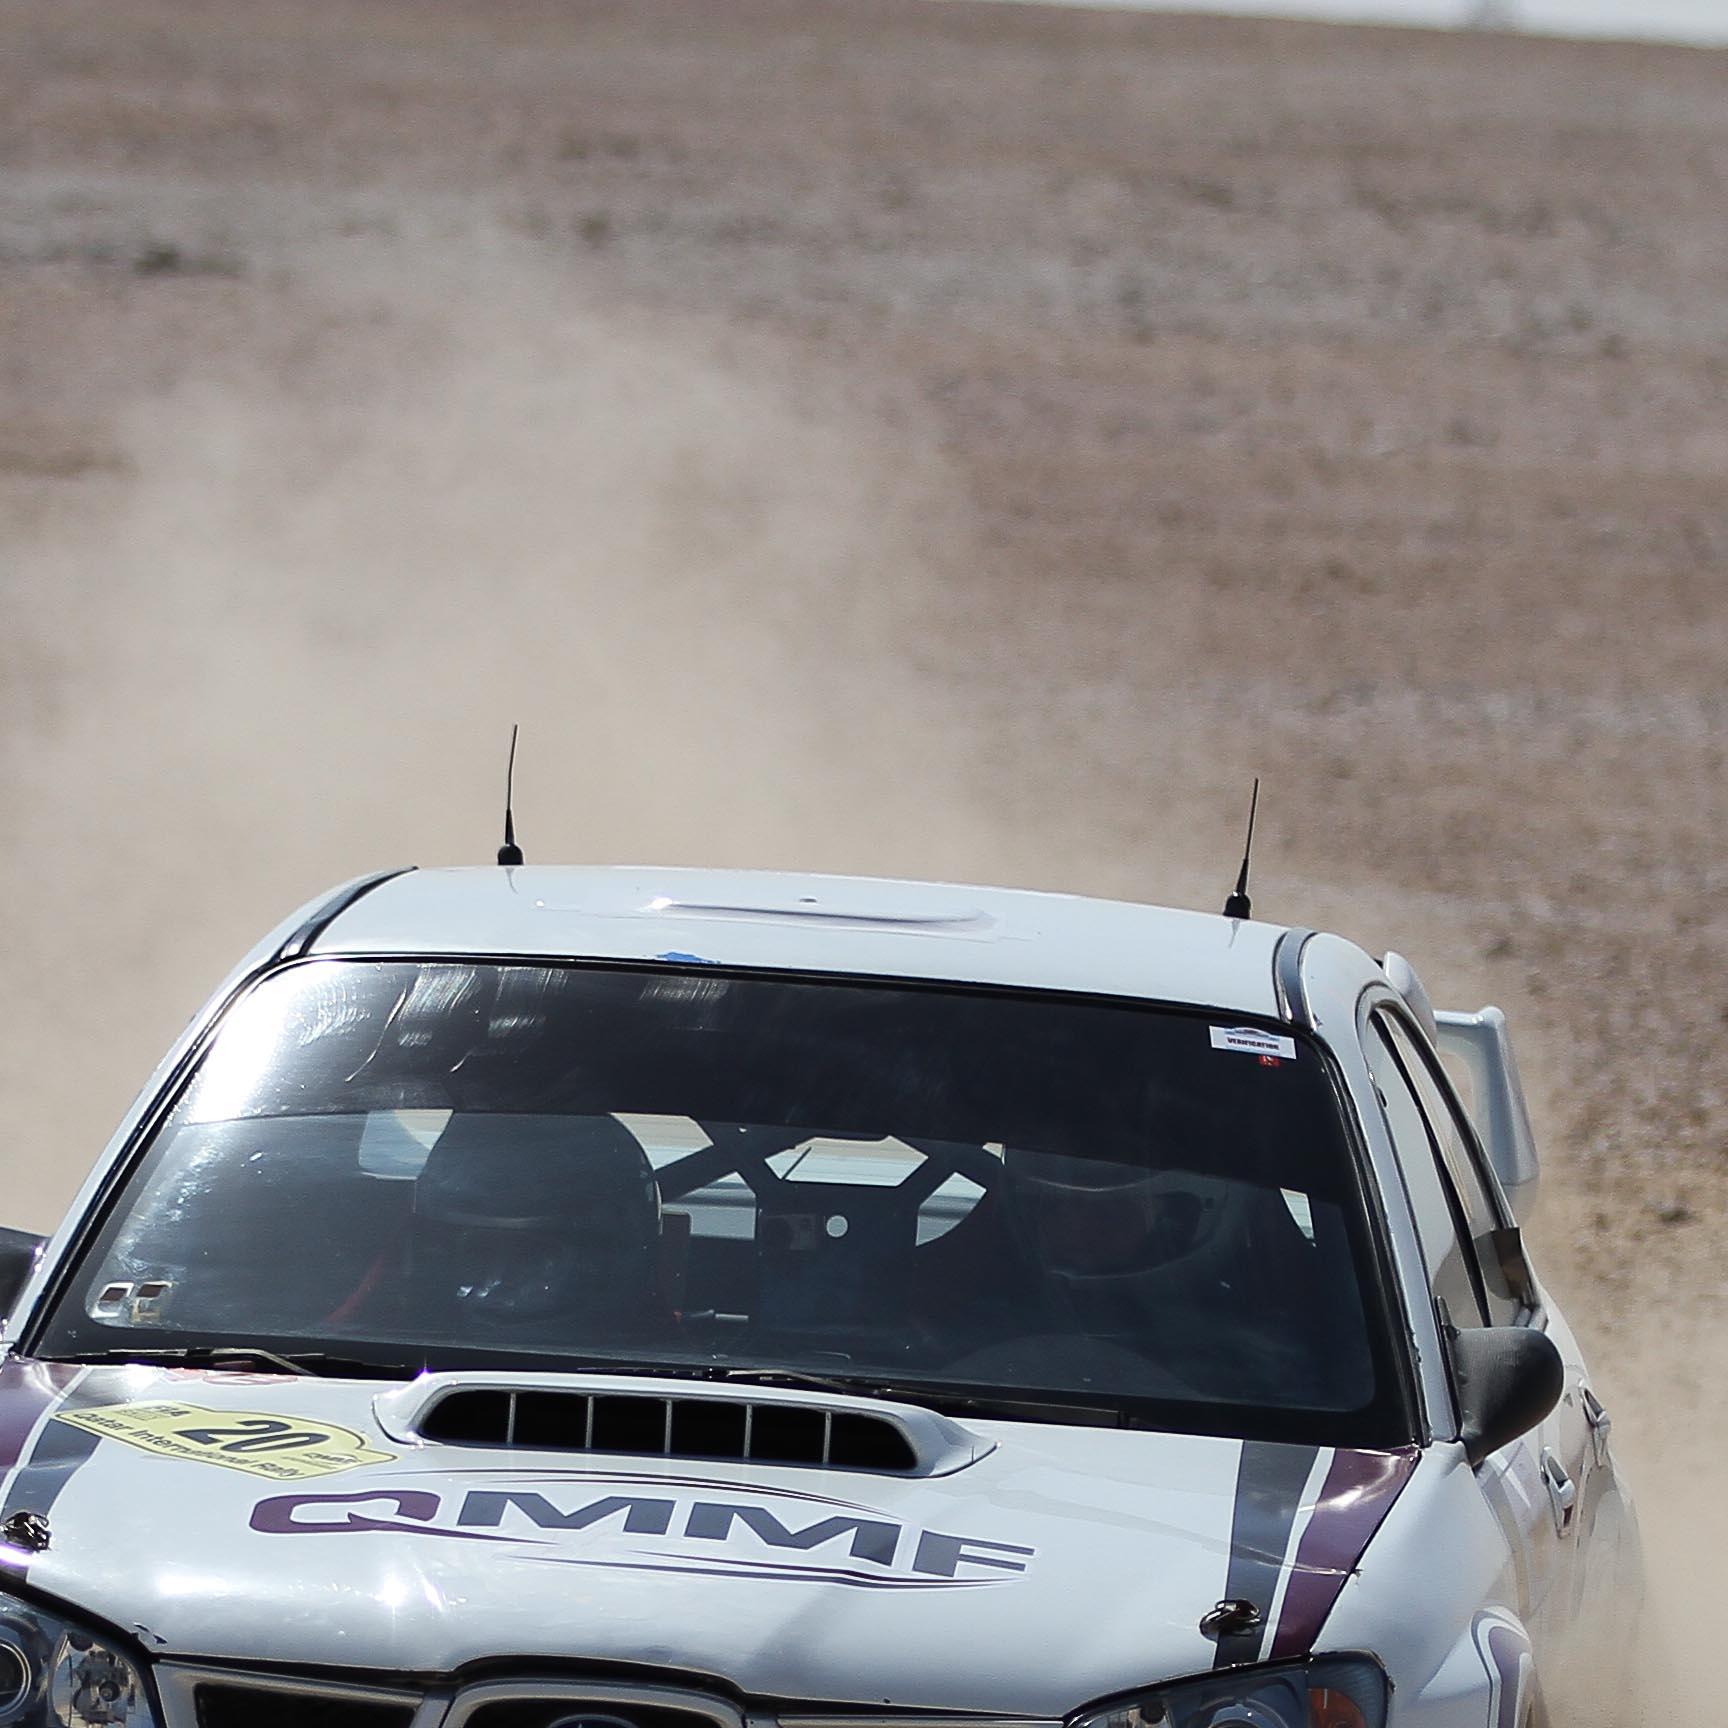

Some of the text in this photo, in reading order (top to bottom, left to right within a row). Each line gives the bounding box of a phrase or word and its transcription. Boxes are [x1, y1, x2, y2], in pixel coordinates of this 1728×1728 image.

[73, 1412, 134, 1431] Qatar
[128, 1429, 258, 1463] International
[175, 1420, 330, 1452] 20
[250, 1490, 1036, 1577] QMMF
